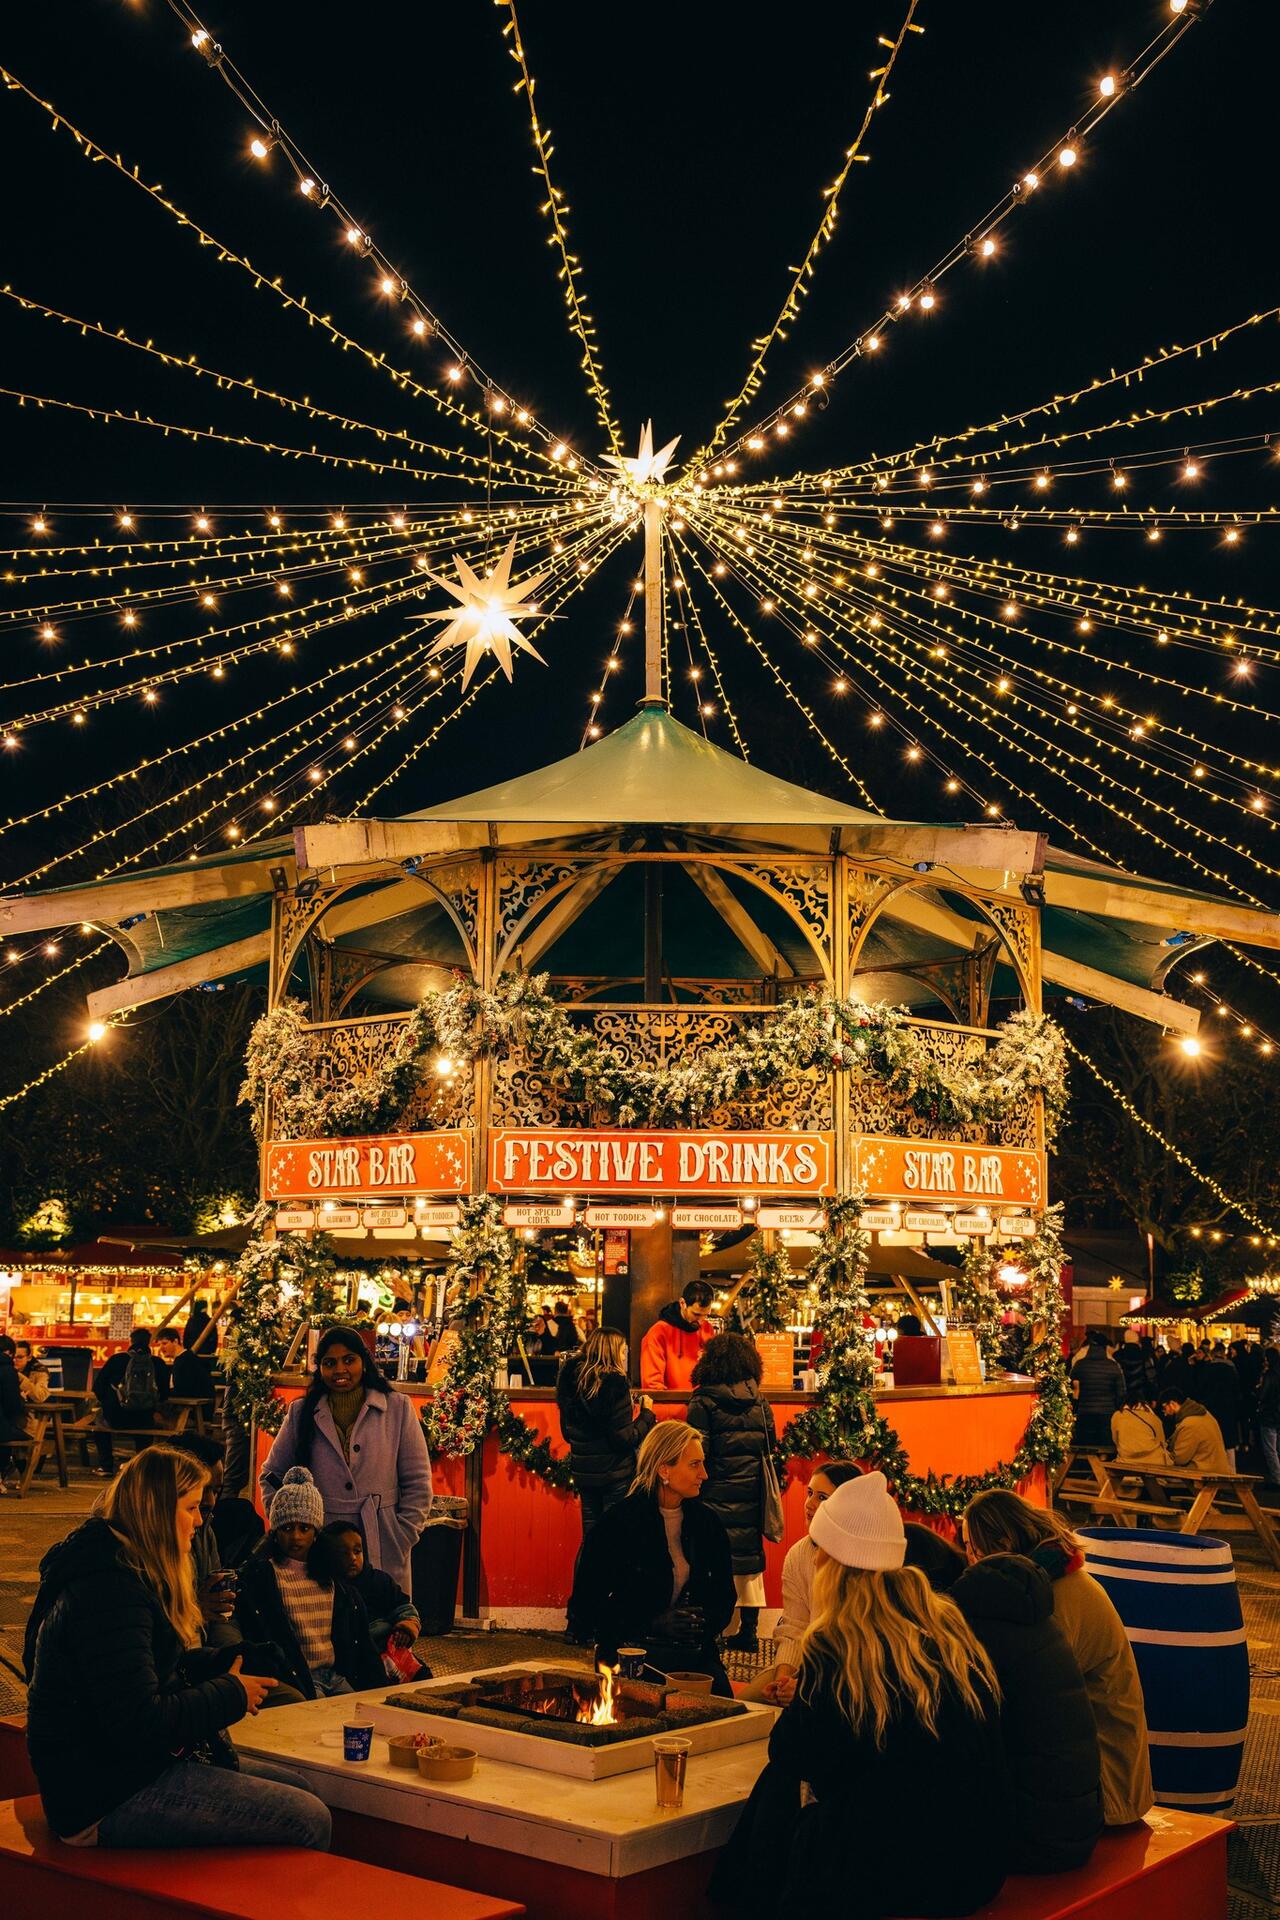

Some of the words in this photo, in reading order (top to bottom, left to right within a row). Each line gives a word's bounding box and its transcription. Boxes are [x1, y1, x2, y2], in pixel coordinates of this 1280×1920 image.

[308, 1147, 361, 1188] STAR
[369, 1143, 416, 1186] BAR
[503, 1140, 664, 1183] FESTIVE
[679, 1140, 819, 1184] DRINKS
[903, 1151, 957, 1192] STAR
[963, 1155, 1004, 1195] BAR
[516, 1208, 531, 1216] HOT
[534, 1208, 561, 1216] SPICED
[527, 1216, 550, 1224] CIDER
[595, 1213, 610, 1221] HOT
[613, 1213, 647, 1221] TODDIES
[676, 1214, 691, 1222] HOT
[694, 1214, 738, 1222] CHOCOLATE
[779, 1215, 804, 1223] BEERS
